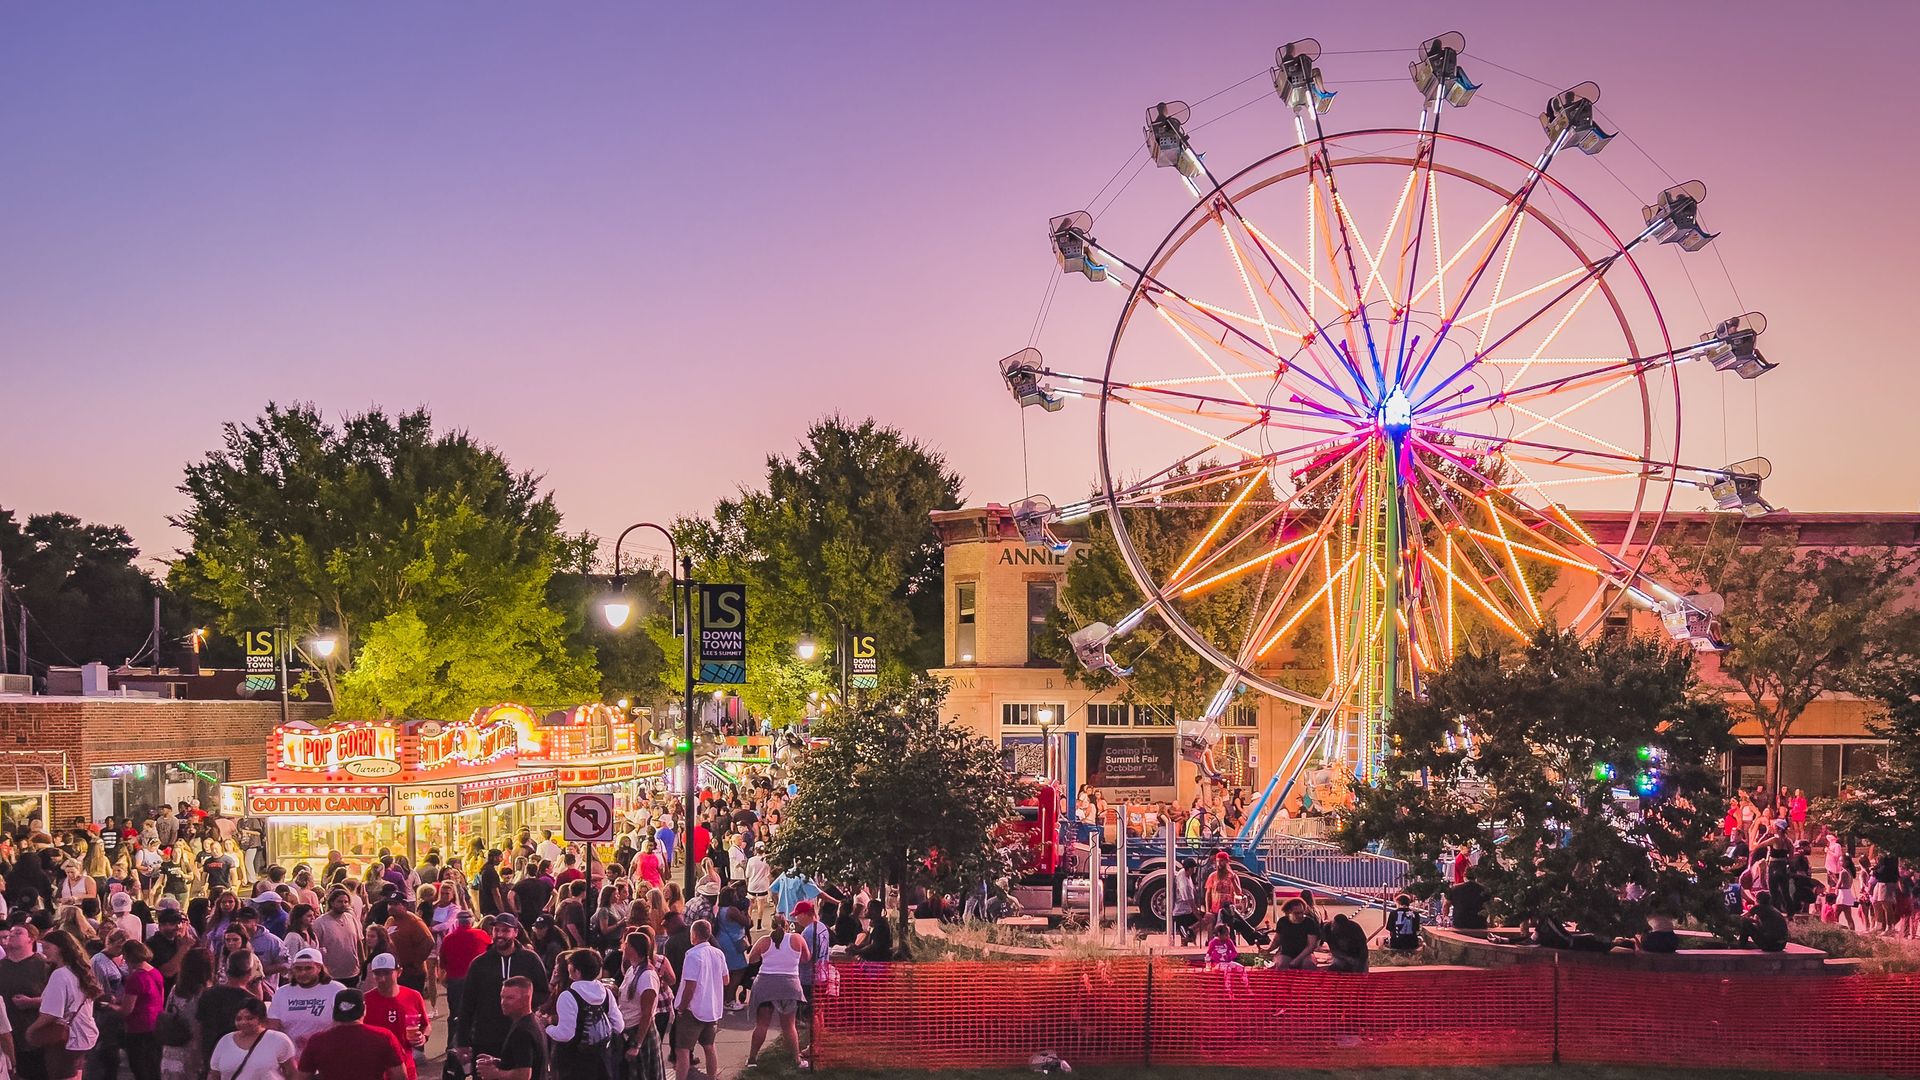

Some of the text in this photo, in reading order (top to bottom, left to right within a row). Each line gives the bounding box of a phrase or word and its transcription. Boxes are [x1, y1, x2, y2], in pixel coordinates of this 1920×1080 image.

[999, 548, 1065, 566] ANNIE
[703, 591, 742, 629] LS
[702, 631, 742, 640] DOWN
[246, 631, 273, 656] LS
[702, 640, 742, 649] TOWN
[853, 636, 876, 658] LS
[303, 728, 377, 766] POP CORN
[1105, 746, 1152, 757] Coming to
[1105, 755, 1159, 764] Summit Fair
[352, 762, 394, 774] Turner's
[1105, 763, 1159, 772] October '22
[252, 797, 322, 813] COTTON
[324, 797, 384, 812] CANDY
[288, 998, 326, 1009] Wrangler
[310, 1005, 325, 1017] 47
